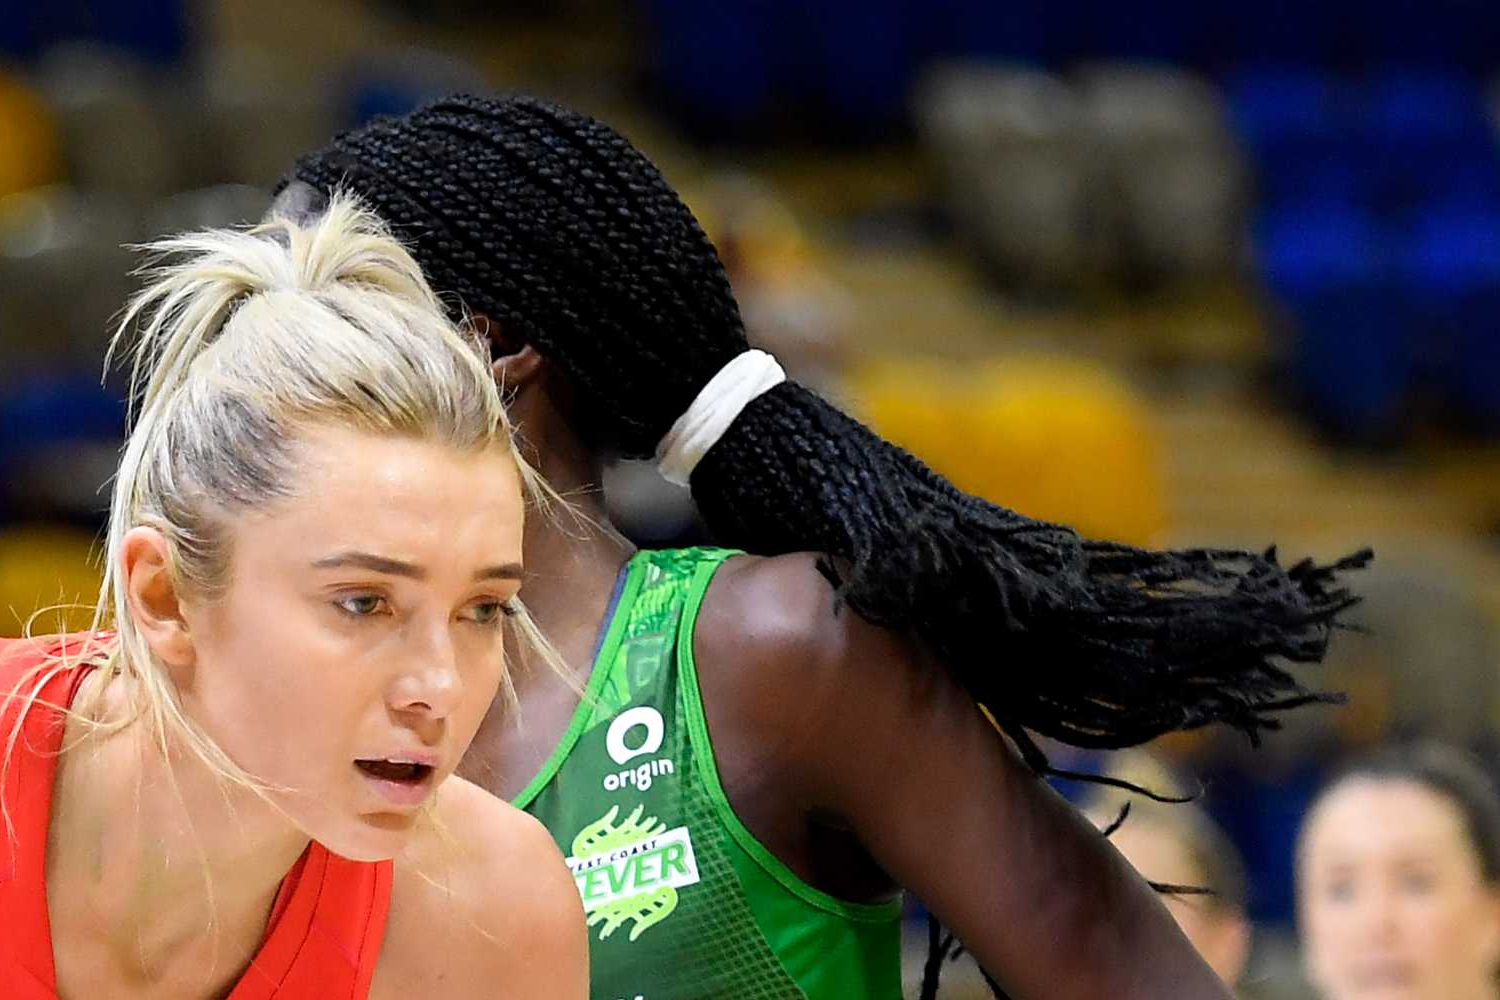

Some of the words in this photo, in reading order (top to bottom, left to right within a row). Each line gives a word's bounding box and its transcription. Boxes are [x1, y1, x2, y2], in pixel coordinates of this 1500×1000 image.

[603, 759, 674, 791] origin
[570, 857, 602, 872] EST
[610, 840, 657, 862] COAST
[580, 842, 687, 899] EVER
